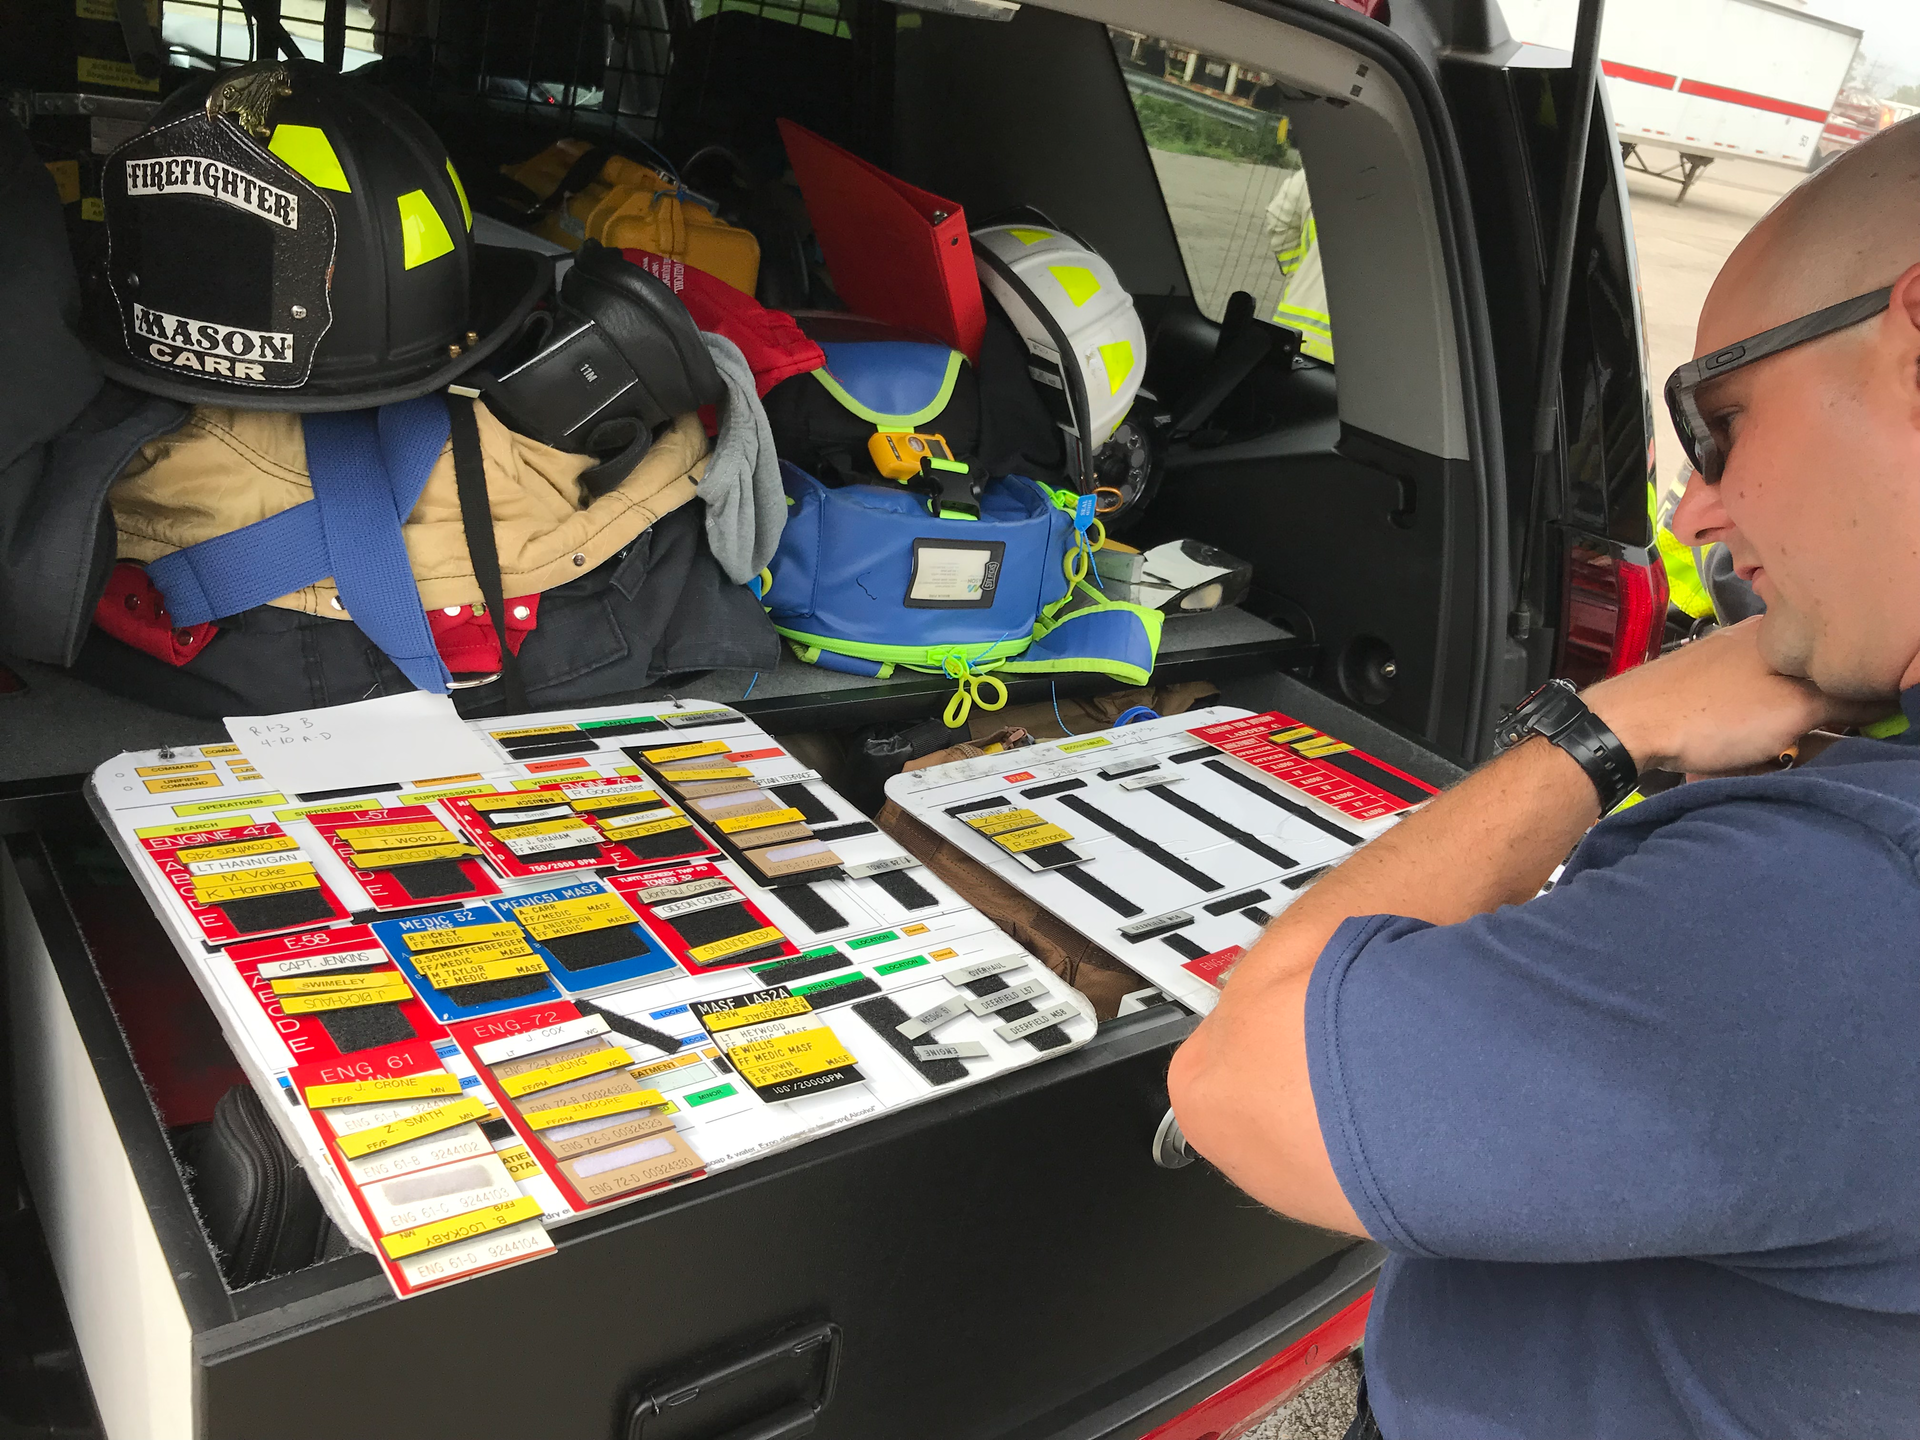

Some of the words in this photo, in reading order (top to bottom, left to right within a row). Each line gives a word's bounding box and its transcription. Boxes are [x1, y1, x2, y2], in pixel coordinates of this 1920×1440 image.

[129, 161, 291, 224] FIREFIGHTER
[139, 307, 288, 361] MASON
[149, 344, 266, 381] CARR
[580, 363, 598, 383] 11M
[1225, 726, 1269, 739] LADDER
[151, 764, 199, 772] COMMAND
[160, 781, 209, 790] COMMAND
[163, 776, 200, 785] UNIFIED
[531, 774, 584, 787] VENTILATION
[1009, 774, 1030, 783] PAR
[413, 789, 476, 801] SUPPRESSION
[586, 783, 645, 796] Goodpaster
[197, 799, 264, 812] OPERATIONS
[608, 795, 640, 803] Hess
[294, 804, 364, 818] SUPPRESSION
[353, 808, 390, 821] L-57
[173, 822, 219, 833] SEARCH
[563, 822, 586, 831] MASF
[149, 829, 237, 848] ENGINE
[243, 824, 272, 836] 47
[398, 834, 438, 844] WOOD
[532, 843, 556, 852] MEDIC
[576, 835, 598, 844] MASF
[186, 851, 214, 861] 245
[196, 863, 215, 872] LT
[219, 853, 299, 870] HANNIGAN
[378, 850, 442, 863] WEDDING
[245, 867, 287, 879] Voke
[529, 861, 575, 873] 750/2000
[617, 869, 677, 883] TURTLECREEK
[676, 867, 695, 876] TWP
[642, 876, 680, 887] TOWER
[231, 878, 304, 896] Hannigan
[562, 883, 600, 899] MASF
[532, 904, 558, 914] CARR
[587, 901, 613, 912] MASF
[399, 914, 450, 931] MEDIC
[453, 911, 476, 922] 52
[523, 909, 572, 924] FF/MEDIC
[541, 915, 593, 930] ANDERSON
[606, 914, 632, 925] MASF
[420, 929, 459, 940] HICKEY
[491, 929, 523, 939] MASF
[551, 924, 584, 936] MEDIC
[748, 930, 773, 943] KEN
[283, 933, 331, 949] E-58
[428, 936, 465, 947] MEDIC
[703, 935, 749, 955] BUNTING
[856, 934, 891, 946] LOCATION
[278, 960, 317, 973] CAPT.
[320, 952, 370, 968] JENKINS
[419, 956, 474, 973] FF/MEDIC
[500, 946, 527, 957] MASF
[884, 959, 919, 973] LOCATION
[445, 964, 486, 977] TAYLOR
[454, 972, 489, 985] MEDIC
[515, 963, 544, 975] MASF
[967, 962, 1007, 978] OVERHAUL
[302, 977, 366, 989] SWIMELEY
[697, 999, 737, 1017] MASF
[744, 987, 790, 1007] LA52A
[760, 999, 790, 1011] MEDIC
[980, 991, 1020, 1010] DEERFIELD
[714, 1010, 740, 1022] MASF
[473, 1011, 562, 1039] ENG-72
[541, 1026, 566, 1038] COX
[740, 1023, 786, 1039] HEYWOOD
[1009, 1015, 1049, 1035] DEERFIELD
[740, 1040, 775, 1055] WILLIS
[754, 1049, 786, 1063] MEDIC
[788, 1042, 813, 1055] MASF
[924, 1046, 960, 1058] ENGINE
[320, 1062, 374, 1083] ENG
[387, 1053, 415, 1069] 61
[631, 1062, 677, 1079] EATMENT
[758, 1060, 795, 1075] BROWN
[825, 1054, 851, 1066] MASF
[771, 1067, 803, 1080] MEDIC
[374, 1077, 419, 1090] CRONE
[521, 1080, 550, 1093] FF/PM
[330, 1095, 354, 1104] FF/P
[698, 1088, 723, 1101] MINOR
[344, 1116, 371, 1131] ENG
[404, 1109, 445, 1127] SMITH
[559, 1139, 583, 1154] ENG
[584, 1131, 611, 1146] 72-C
[612, 1118, 664, 1139] 00924329
[366, 1139, 389, 1151] FF/P
[363, 1163, 390, 1178] ENG
[393, 1154, 422, 1170] 61-B
[430, 1140, 481, 1161] 9244102
[589, 1181, 612, 1197] ENG
[613, 1172, 641, 1188] 72-D
[642, 1157, 694, 1180] 00924330
[390, 1212, 418, 1228] ENG
[421, 1202, 450, 1220] 61-C
[458, 1187, 511, 1209] 9244103
[426, 1220, 488, 1248] LOCKABY
[417, 1262, 445, 1279] ENG
[448, 1251, 478, 1271] 61-D
[487, 1235, 540, 1259] 9244104
